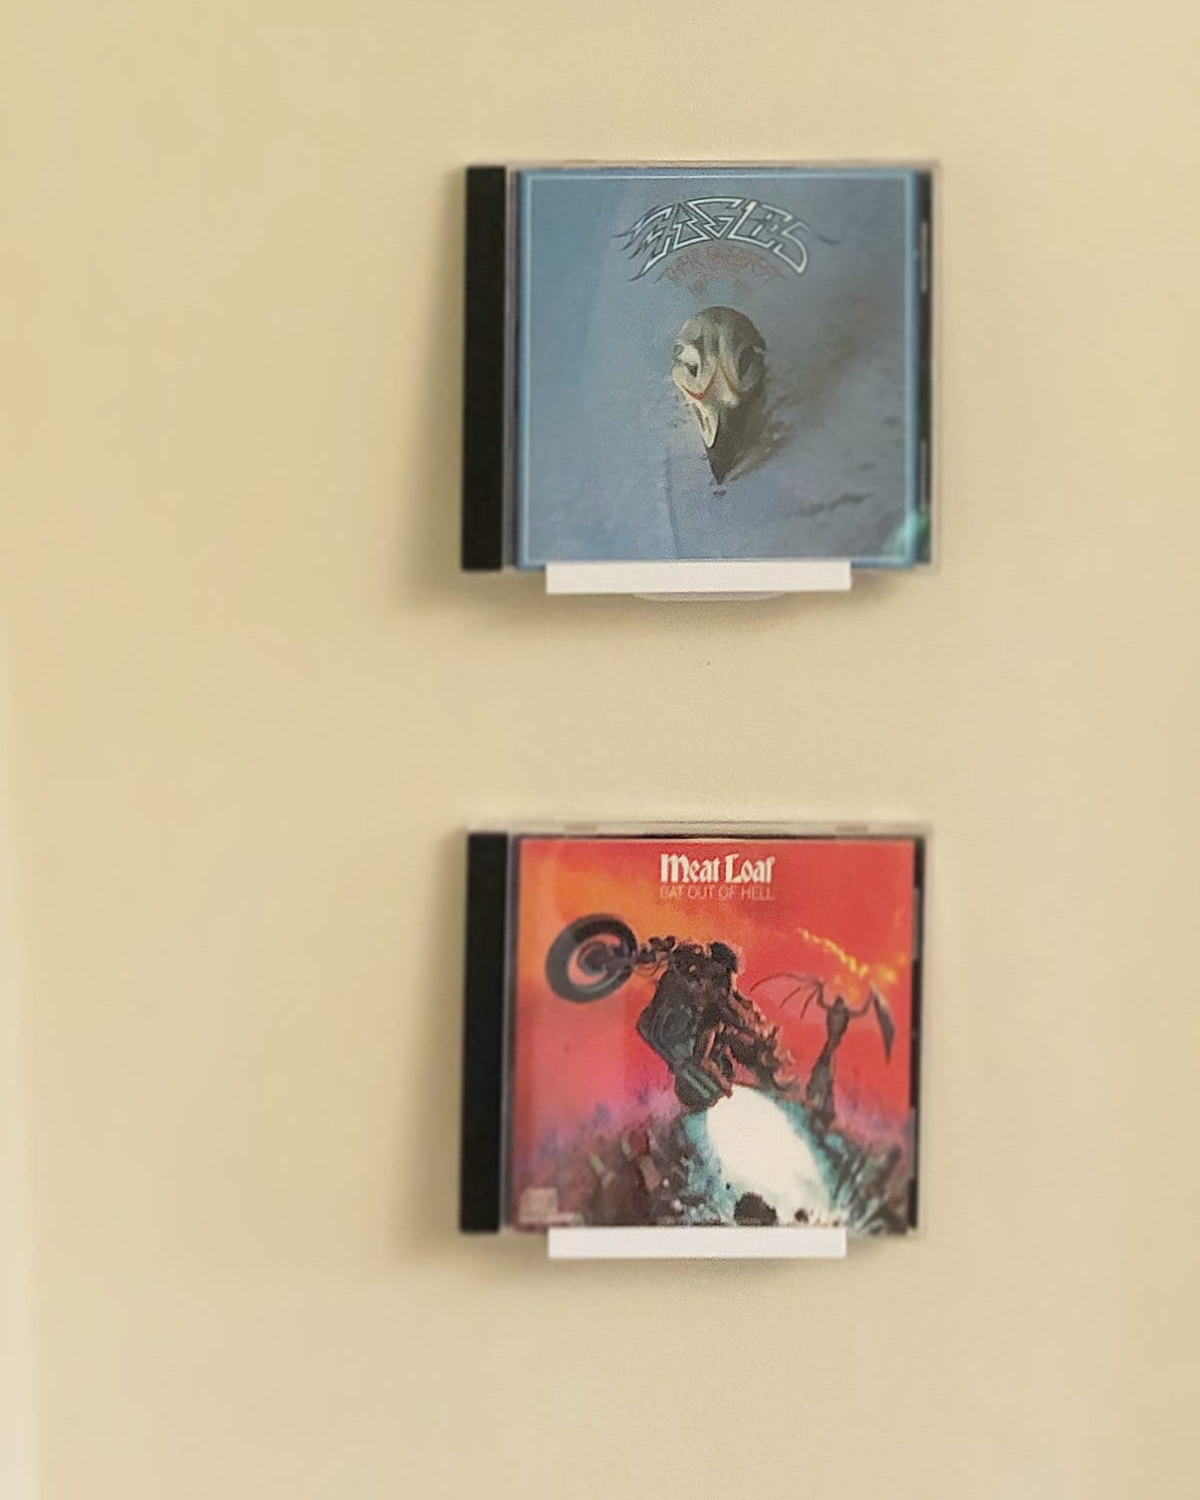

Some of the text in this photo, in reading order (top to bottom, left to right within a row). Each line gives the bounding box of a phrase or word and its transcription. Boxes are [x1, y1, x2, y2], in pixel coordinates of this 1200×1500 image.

[612, 197, 812, 282] EAGLES
[661, 853, 776, 883] Meat Loaf
[660, 884, 775, 900] BAT OUT OF HELL
